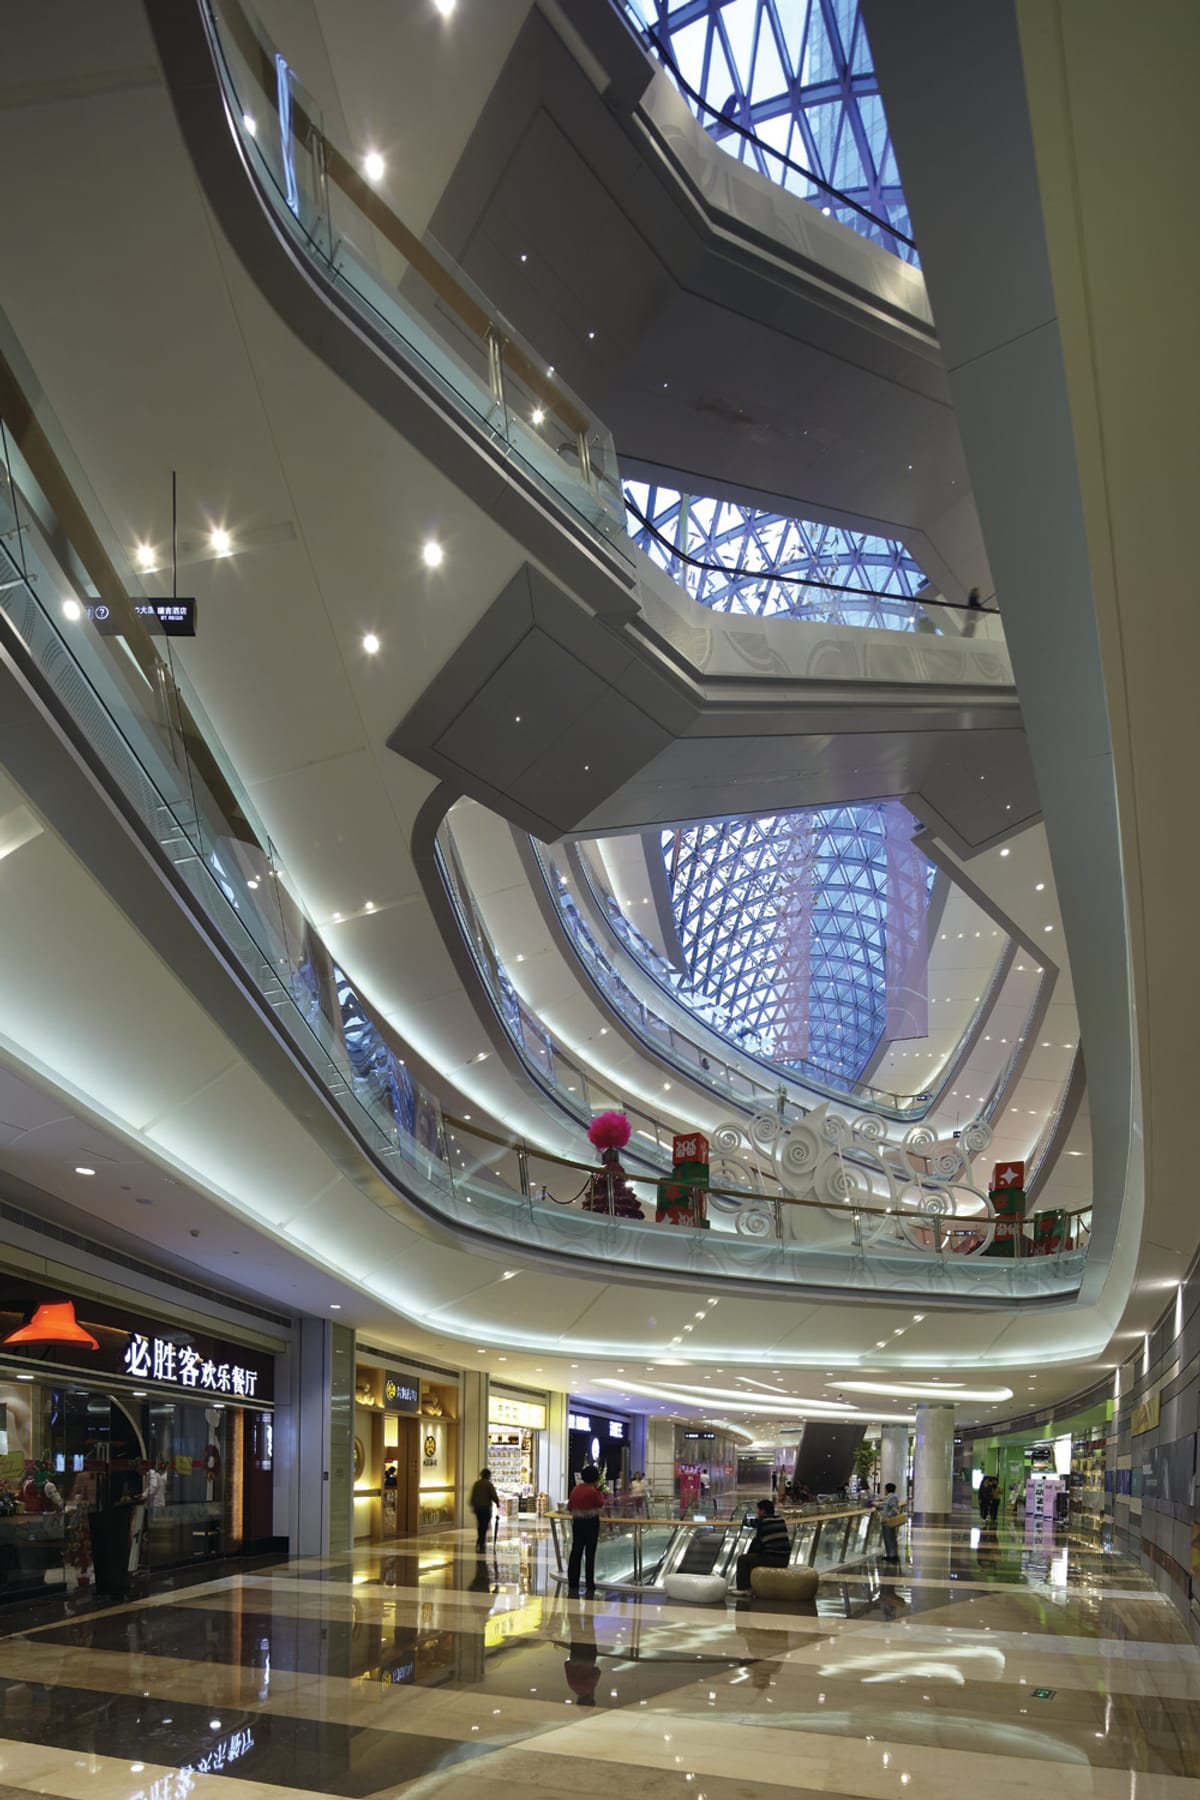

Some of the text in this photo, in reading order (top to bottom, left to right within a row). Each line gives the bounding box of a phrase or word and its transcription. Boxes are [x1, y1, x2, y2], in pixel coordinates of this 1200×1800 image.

[124, 1333, 258, 1396] 必胜客欢乐餐厅
